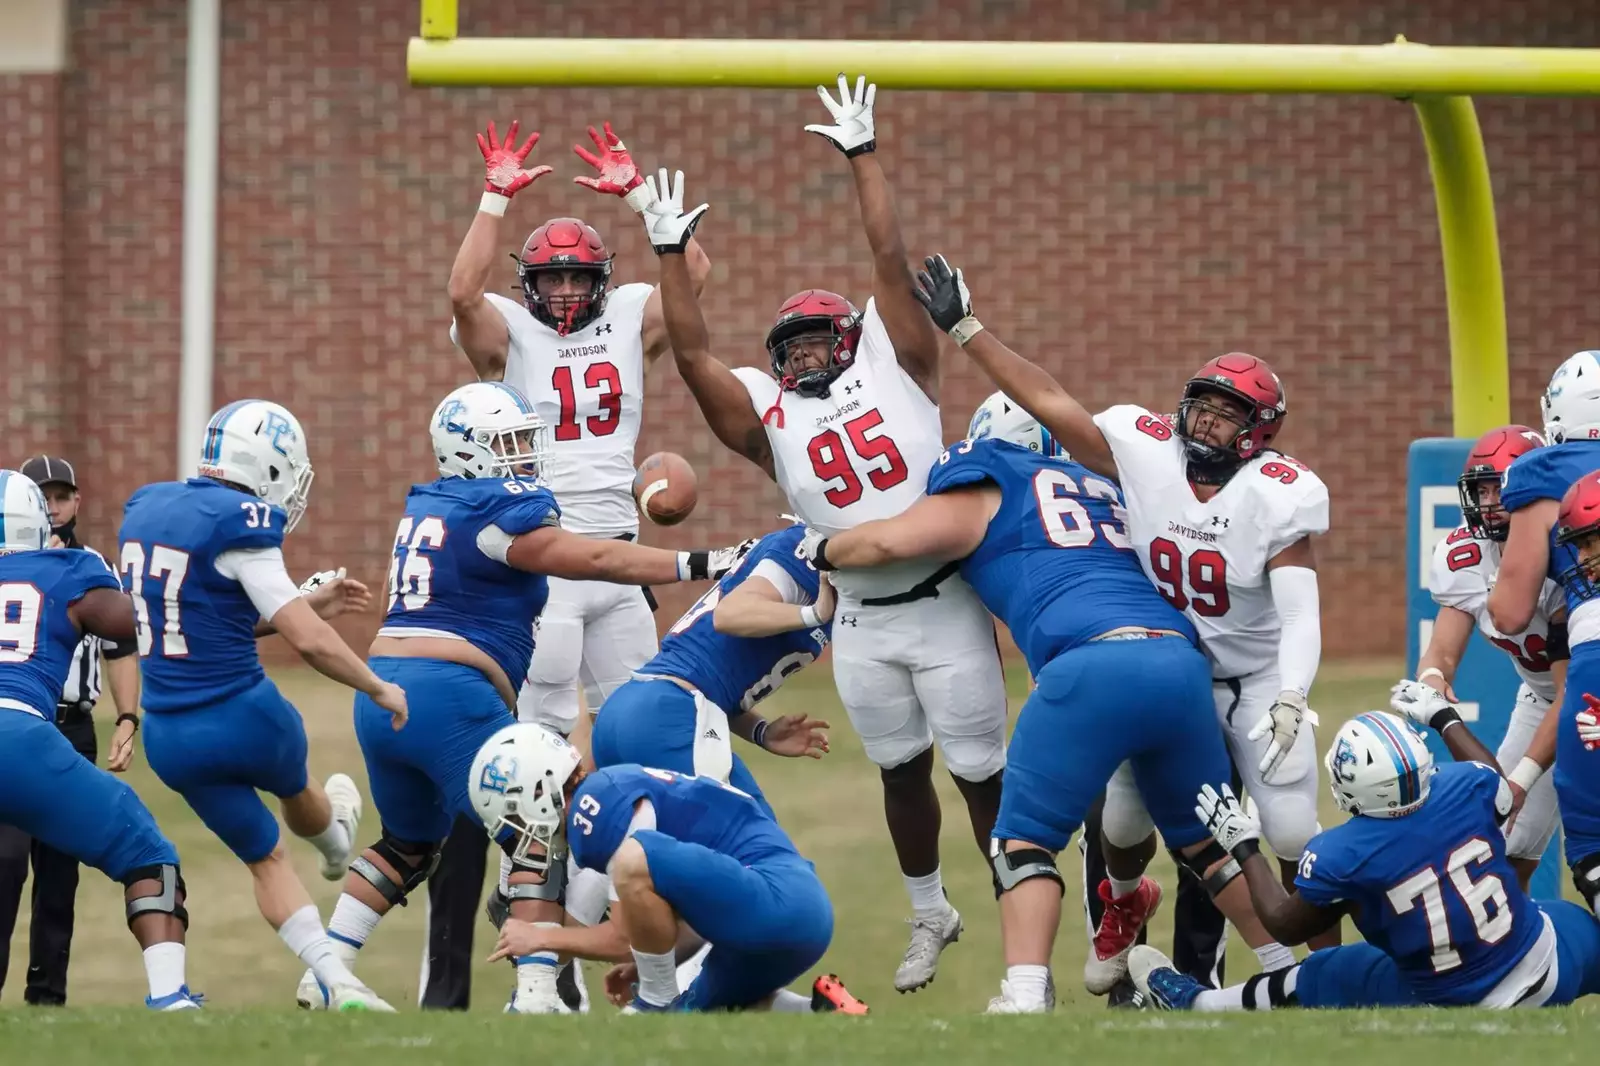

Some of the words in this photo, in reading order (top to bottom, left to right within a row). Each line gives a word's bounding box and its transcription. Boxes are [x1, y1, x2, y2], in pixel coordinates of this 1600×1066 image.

[557, 344, 608, 359] DAVIDSON
[552, 361, 624, 442] 13
[502, 480, 539, 494] 66
[806, 407, 909, 509] 95
[240, 501, 271, 529] 37
[1031, 468, 1138, 550] 63
[1168, 520, 1217, 543] DAVIDSON
[120, 541, 190, 658] 37
[386, 516, 447, 614] 66
[1150, 536, 1231, 617] 99
[572, 794, 601, 837] 39
[1298, 850, 1318, 879] 76
[1386, 837, 1514, 975] 76
